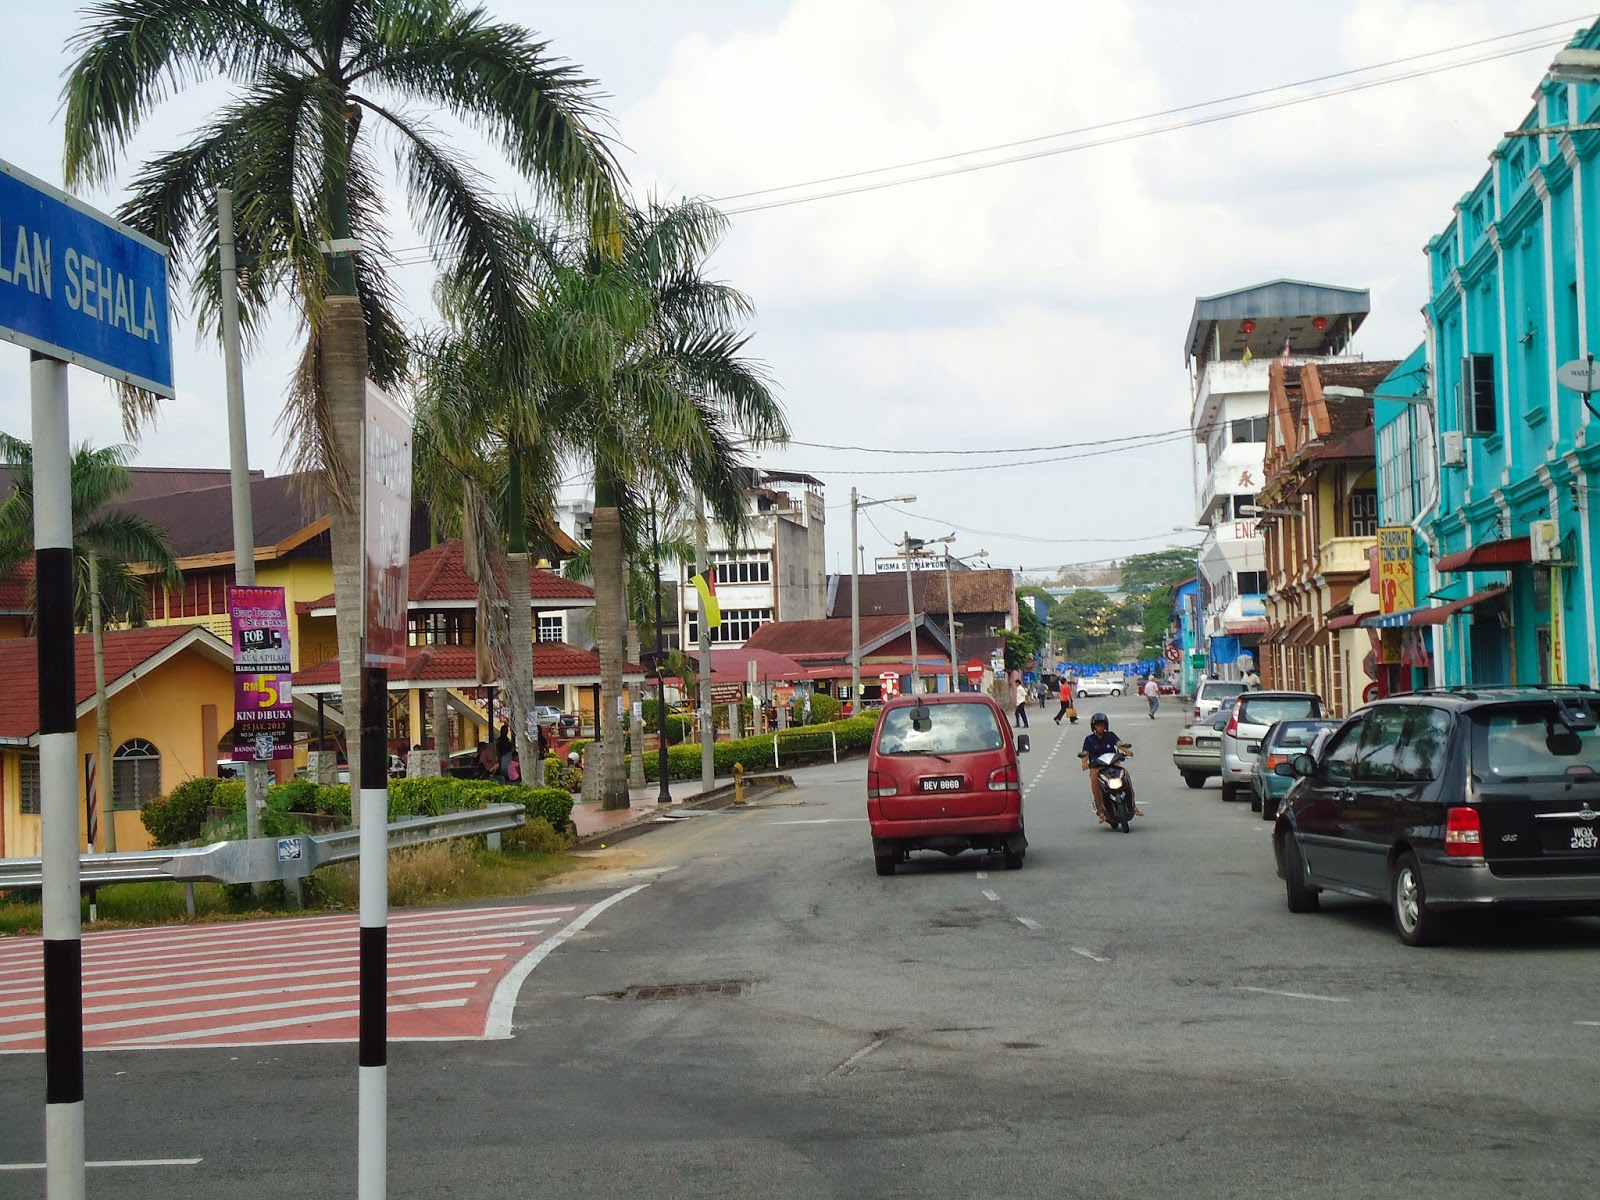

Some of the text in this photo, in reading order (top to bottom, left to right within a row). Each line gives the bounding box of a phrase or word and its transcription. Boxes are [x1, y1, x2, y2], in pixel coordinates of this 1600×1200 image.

[64, 247, 160, 344] SEHALA
[1238, 470, 1255, 488] 永
[1380, 530, 1408, 546] SYARIKAT
[1380, 547, 1395, 562] TONG
[877, 563, 900, 571] WISMA
[231, 588, 283, 599] PROMOSI
[253, 607, 281, 617] TUDUNG
[246, 617, 286, 627] SELENDANG
[244, 630, 264, 642] FOB
[241, 654, 287, 662] KUALA PILAH
[236, 710, 292, 720] KINI DIBUKA
[242, 723, 251, 731] 25
[267, 722, 286, 730] 2013
[923, 781, 938, 790] BEV
[1570, 837, 1598, 849] 2437
